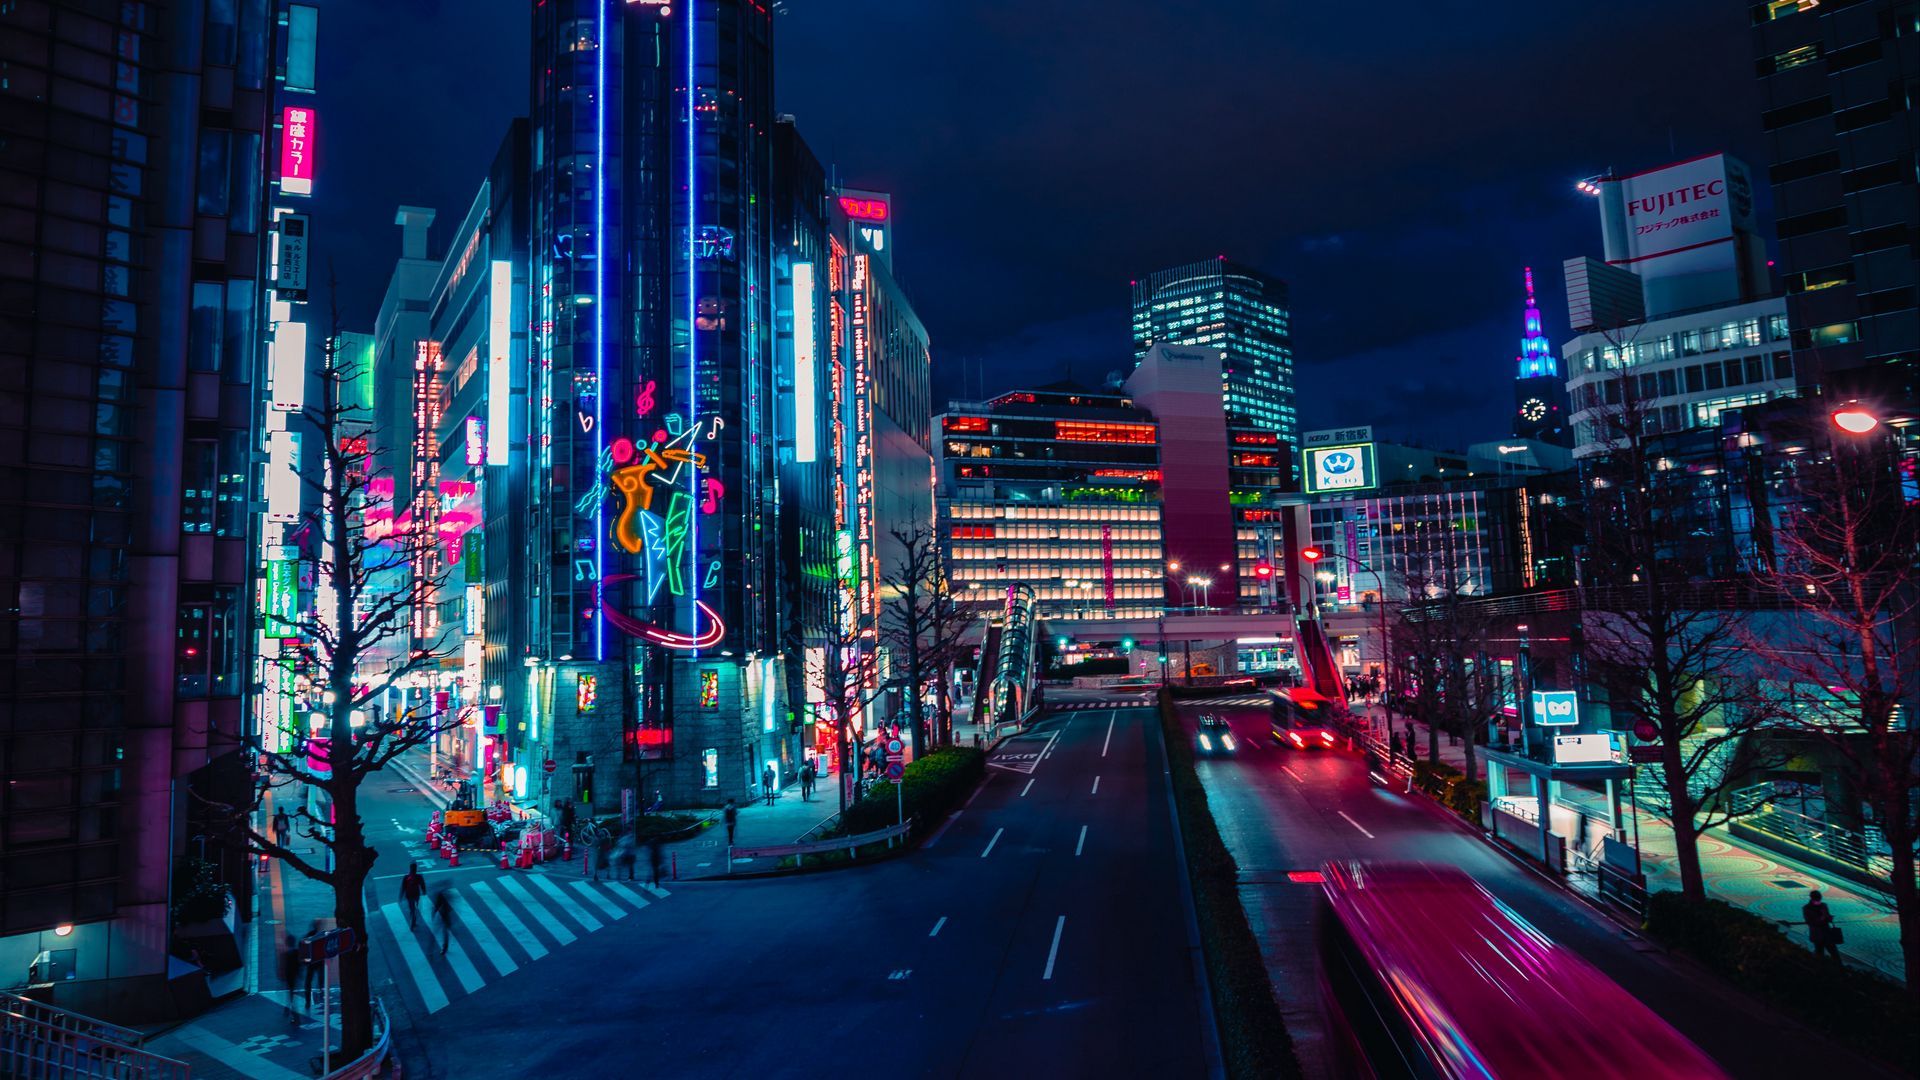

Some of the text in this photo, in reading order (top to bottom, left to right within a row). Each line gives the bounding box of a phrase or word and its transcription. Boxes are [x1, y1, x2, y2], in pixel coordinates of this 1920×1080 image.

[289, 109, 307, 176] 銀座カラー
[1627, 179, 1724, 217] FUJITEC
[1636, 208, 1720, 236] フジテック株式会社
[1335, 428, 1368, 442] 新宿駅
